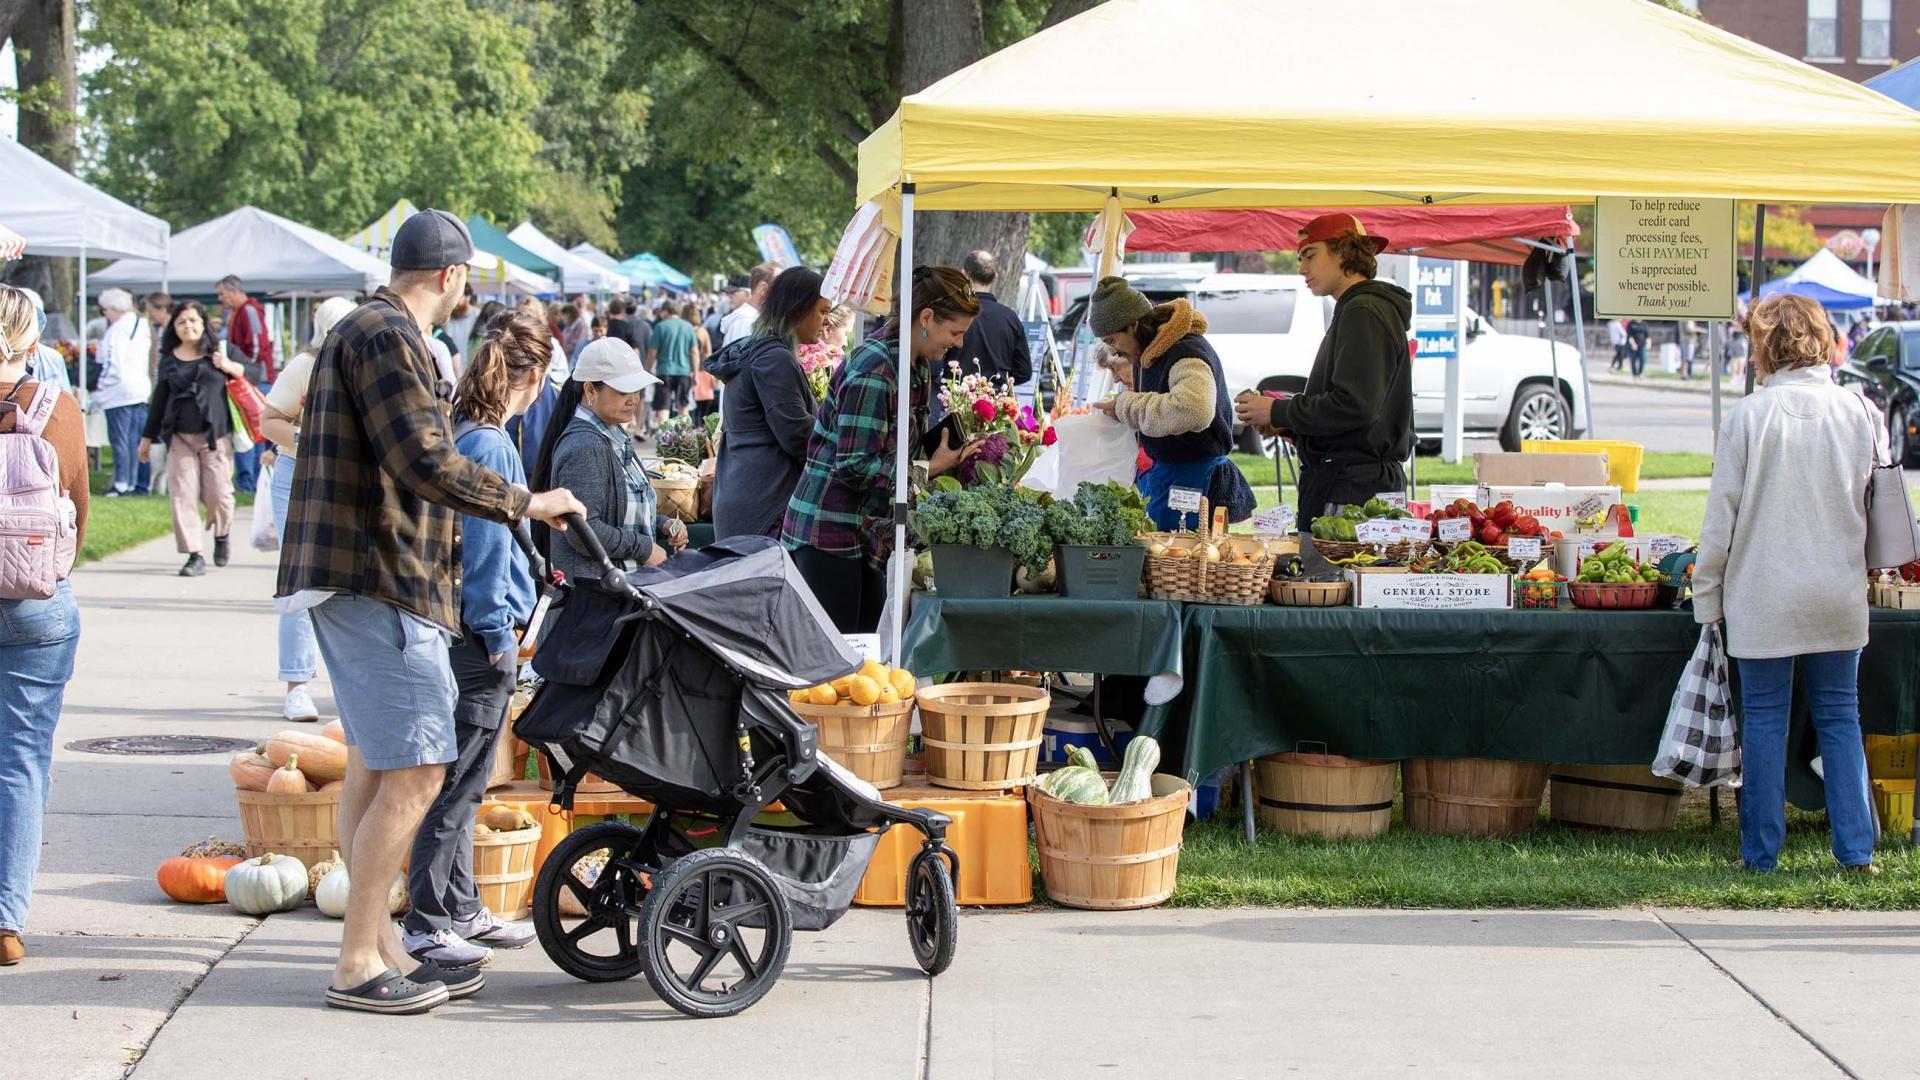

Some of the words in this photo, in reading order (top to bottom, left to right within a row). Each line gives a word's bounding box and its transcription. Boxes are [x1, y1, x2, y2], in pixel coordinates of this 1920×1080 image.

[1629, 199, 1642, 211] To
[1644, 199, 1666, 213] help
[1668, 200, 1701, 212] reduce
[1638, 215, 1666, 227] credit
[1668, 215, 1690, 227] card
[1625, 231, 1677, 246] processing
[1679, 231, 1702, 244] fees,
[1618, 247, 1650, 259] CASH
[1653, 247, 1710, 259] PAYMENT
[1631, 263, 1639, 274] is
[1641, 263, 1697, 278] appreciated
[1618, 279, 1665, 291] whenever
[1667, 279, 1710, 294] possible.
[1637, 295, 1667, 307] Thank
[1668, 296, 1692, 310] you!
[1515, 505, 1562, 519] Quality
[1382, 587, 1444, 596] GENERAL
[1449, 587, 1491, 596] STORE
